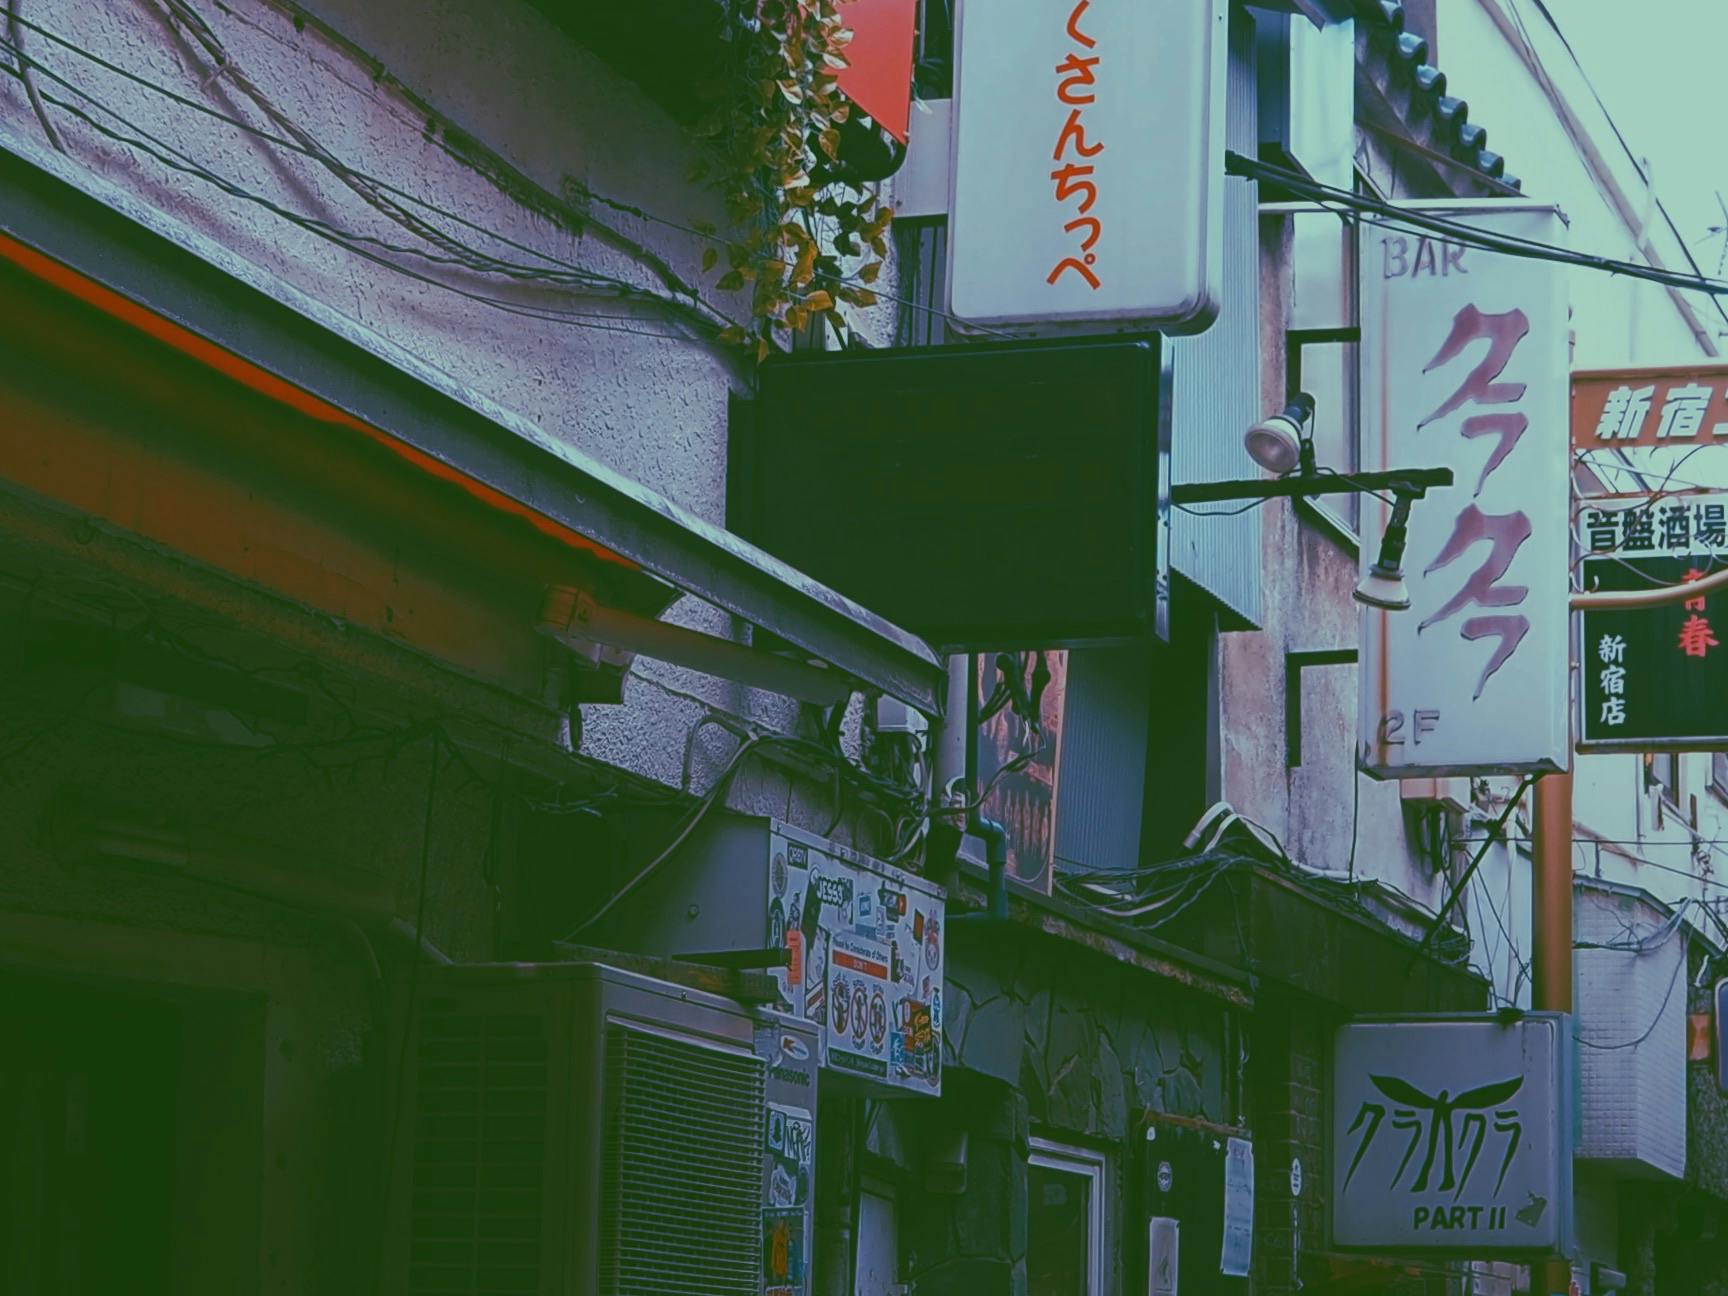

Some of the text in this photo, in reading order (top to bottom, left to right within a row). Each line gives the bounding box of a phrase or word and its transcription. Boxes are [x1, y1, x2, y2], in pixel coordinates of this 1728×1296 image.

[1381, 234, 1469, 280] BAR
[1586, 504, 1728, 552] 音盤酒場
[1597, 633, 1628, 727] 新宿店
[1378, 709, 1441, 747] 2F
[1413, 1205, 1507, 1231] PART II
